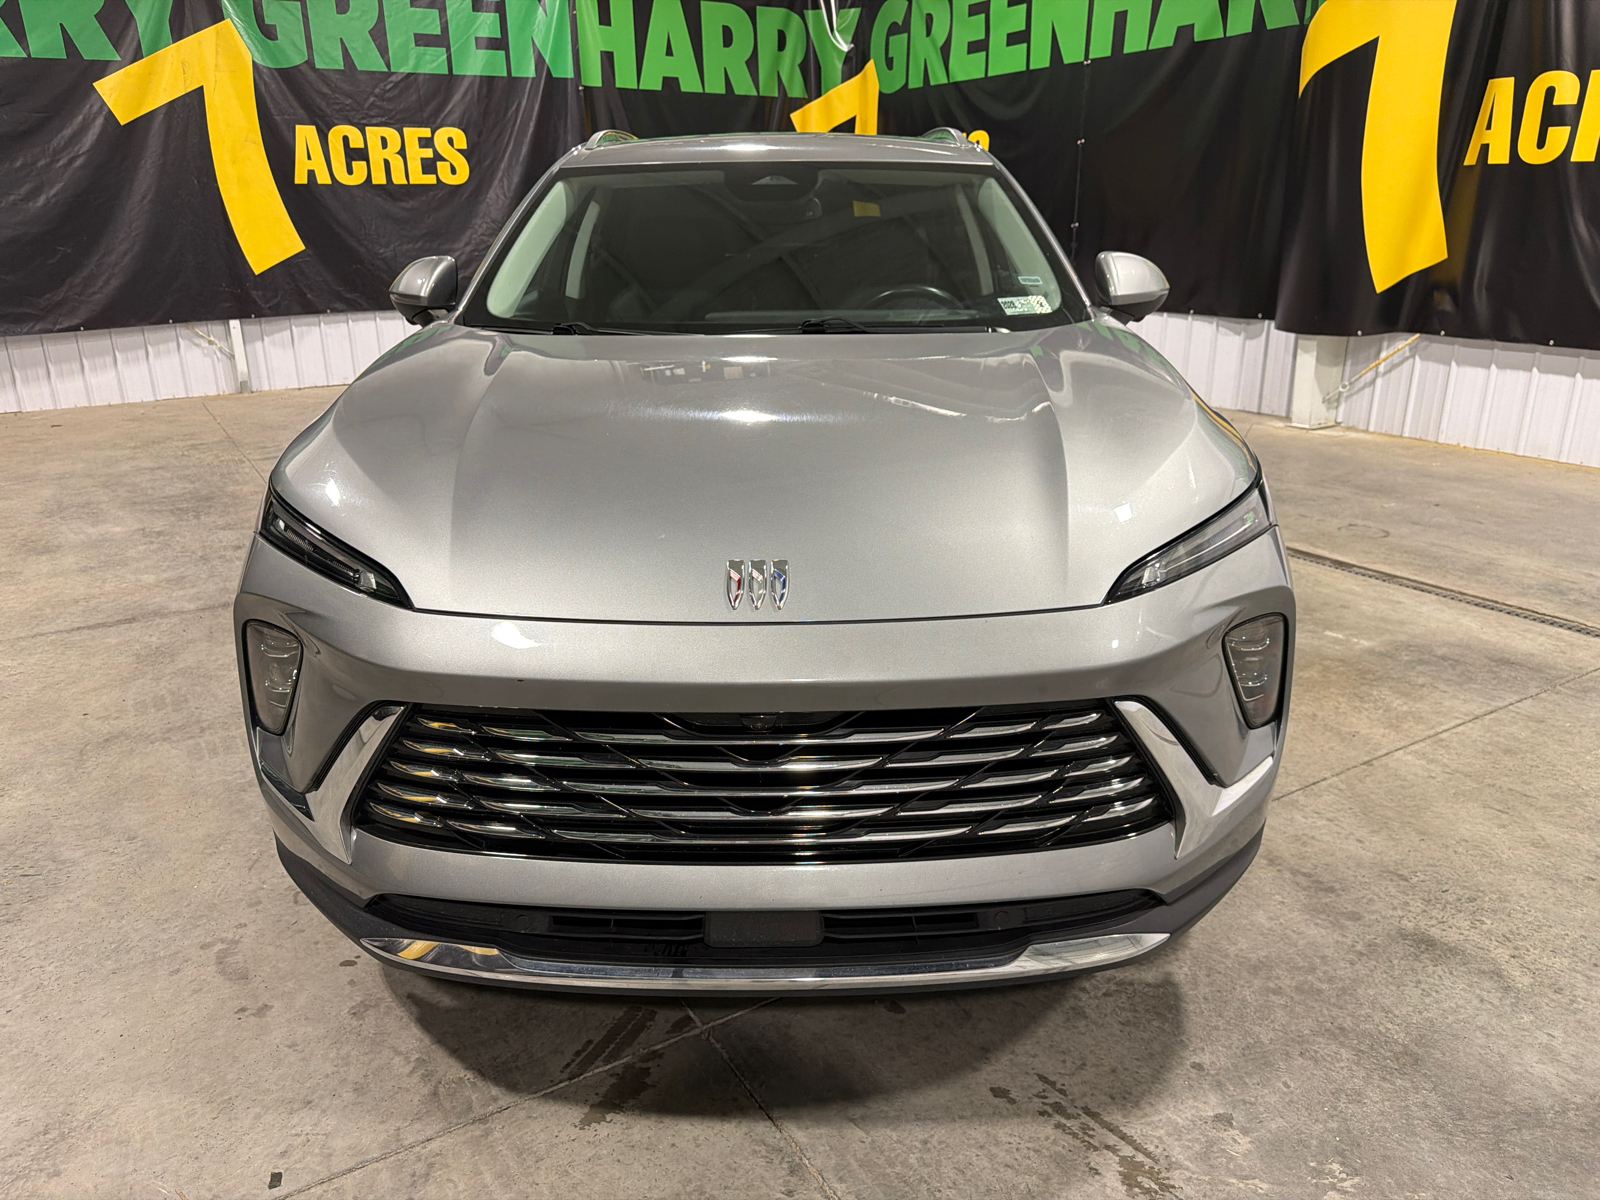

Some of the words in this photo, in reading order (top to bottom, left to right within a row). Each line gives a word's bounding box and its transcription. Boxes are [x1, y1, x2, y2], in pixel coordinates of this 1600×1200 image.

[222, 0, 574, 78] GREEN
[576, 0, 861, 98] HARRY
[870, 0, 1089, 94] GREEN
[93, 18, 305, 275] 7
[295, 124, 470, 186] ACRES
[1299, 0, 1457, 294] 7
